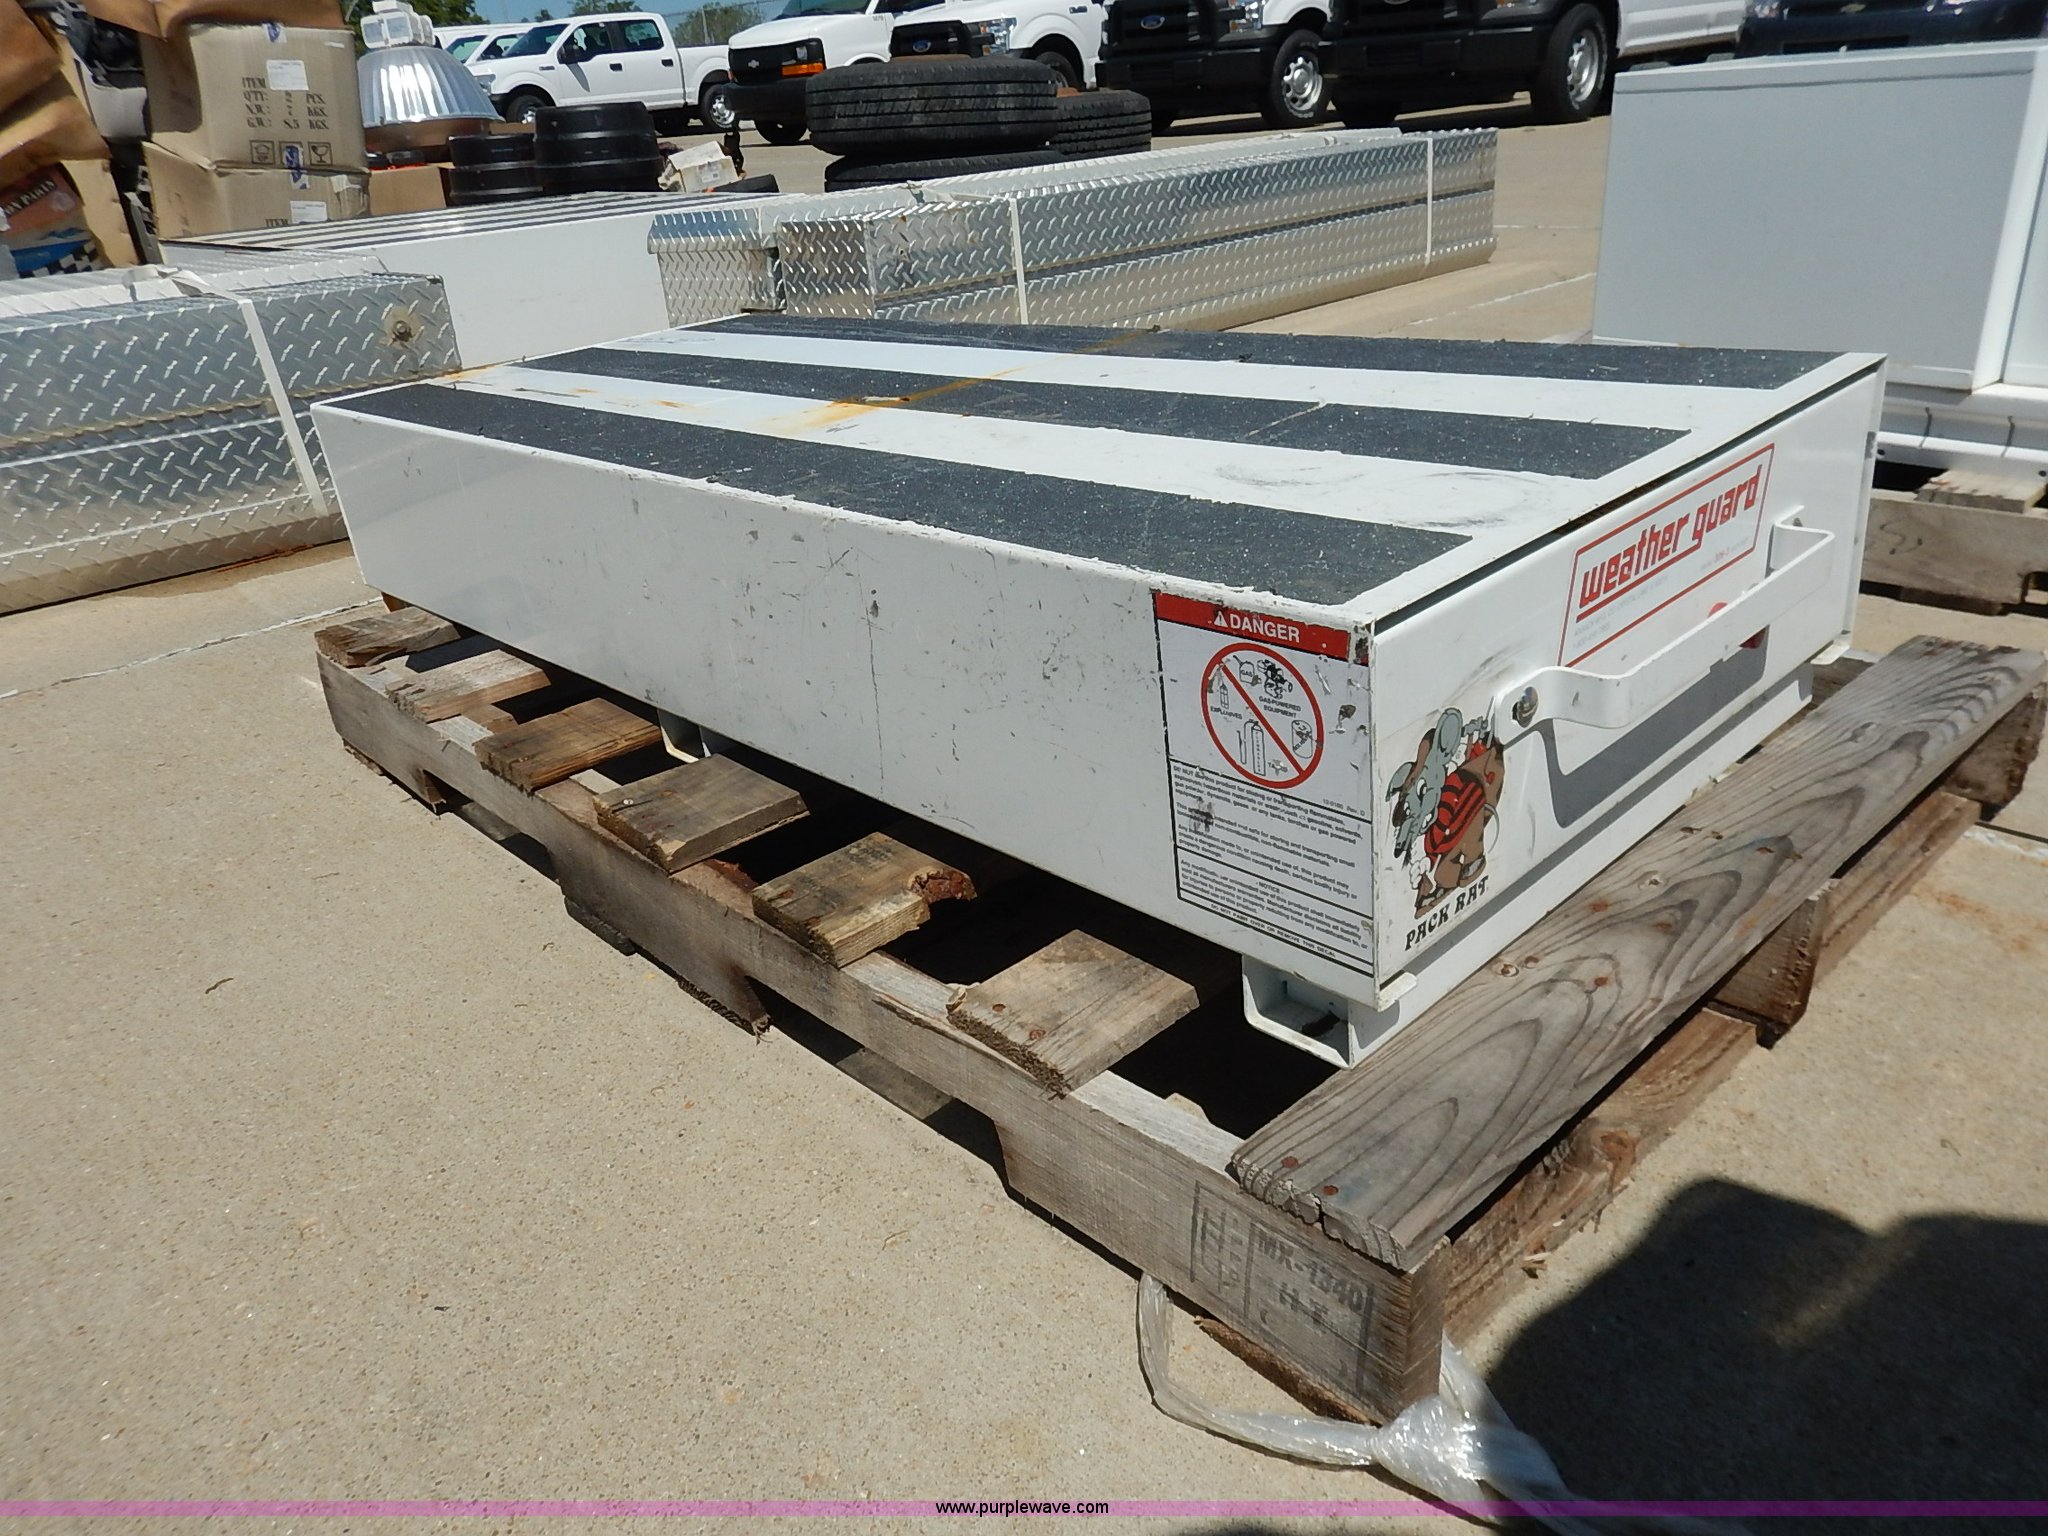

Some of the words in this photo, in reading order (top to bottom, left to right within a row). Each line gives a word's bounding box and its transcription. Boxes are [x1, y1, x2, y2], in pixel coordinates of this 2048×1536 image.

[1578, 512, 1691, 609] weather
[1692, 464, 1763, 547] guard
[1229, 613, 1301, 643] DANGER
[1404, 902, 1450, 951] PACK
[1454, 875, 1489, 915] RAT
